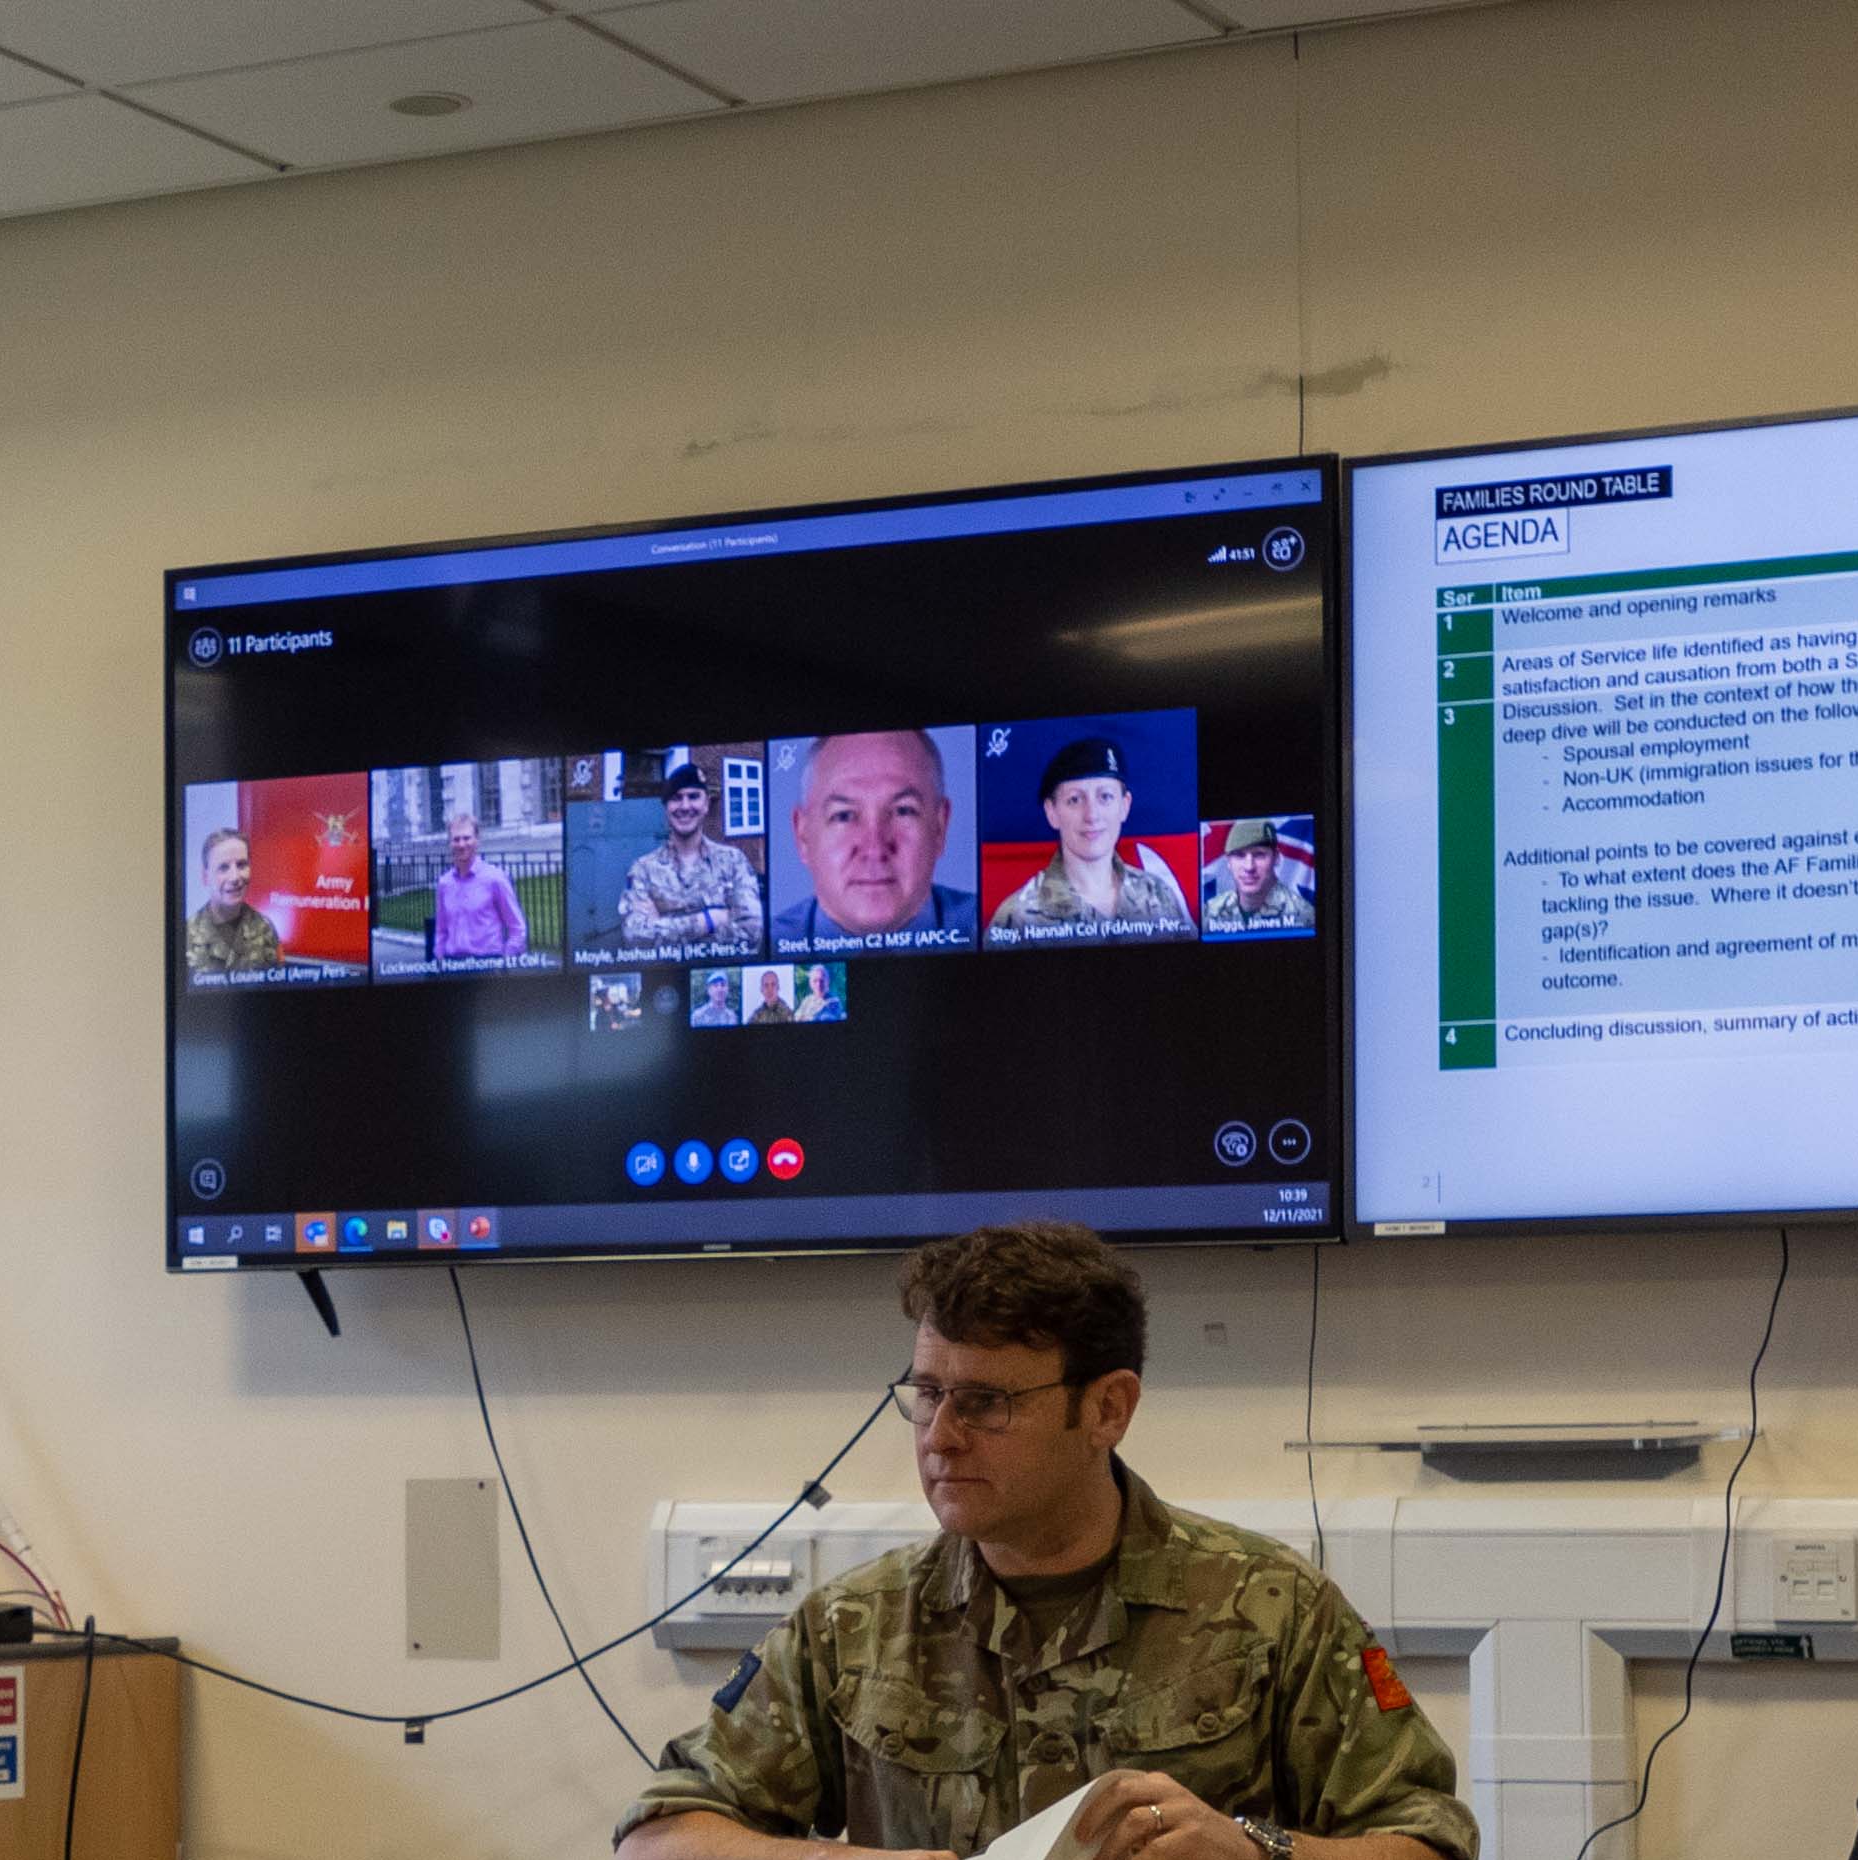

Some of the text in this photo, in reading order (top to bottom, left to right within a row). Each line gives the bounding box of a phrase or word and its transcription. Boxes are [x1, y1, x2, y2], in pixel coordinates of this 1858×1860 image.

[1443, 474, 1659, 514] FAMILIES ROUND TABLE
[1443, 518, 1559, 553] AGENDA
[1443, 590, 1476, 606] Ser
[1502, 586, 1542, 601] Item
[1501, 584, 1777, 626] Welcome and opening remarks
[1443, 614, 1453, 631] 1
[227, 630, 333, 654] 11 Participants
[1501, 651, 1554, 674] Areas
[1558, 650, 1576, 669] of
[1580, 644, 1647, 667] Service
[1652, 641, 1678, 661] life
[1683, 634, 1764, 658] identified
[1769, 635, 1792, 651] as
[1796, 626, 1858, 653] having
[1443, 661, 1455, 679] 2
[1443, 709, 1456, 726] 3
[1563, 732, 1750, 766] Spousal employment
[1563, 765, 1634, 787] Non-UK
[1639, 757, 1750, 786] (immigration
[1755, 753, 1814, 775] issues
[1818, 751, 1842, 770] for
[1562, 786, 1705, 813] Accommodation
[1559, 869, 1580, 888] To
[1583, 866, 1627, 887] what
[1631, 863, 1686, 884] extent
[1691, 860, 1736, 880] does
[1741, 858, 1770, 877] the
[1773, 856, 1799, 876] AF
[315, 874, 354, 894] Army
[269, 891, 361, 912] Remuneration
[990, 925, 1022, 943] Stoy,
[1025, 921, 1073, 939] Hannah
[1076, 920, 1097, 936] Col
[1248, 916, 1281, 931] James
[1541, 918, 1609, 944] gap(s)?
[616, 947, 658, 963] Joshua
[658, 943, 683, 962] Maj
[778, 937, 811, 953] Steel,
[813, 935, 864, 954] Stephen
[865, 932, 884, 948] C2
[885, 931, 913, 947] MSF
[442, 957, 504, 972] Hawthorne
[519, 952, 540, 968] Col
[230, 970, 265, 984] Louise
[267, 968, 286, 982] Col
[288, 966, 321, 983] (Army
[1541, 969, 1622, 990] outcome.
[1445, 1027, 1457, 1046] 4
[1504, 1020, 1604, 1047] Concluding
[1608, 1015, 1707, 1042] discussion,
[1713, 1015, 1798, 1037] summary
[1802, 1010, 1821, 1029] of
[1263, 1206, 1324, 1222] 12/11/2021
